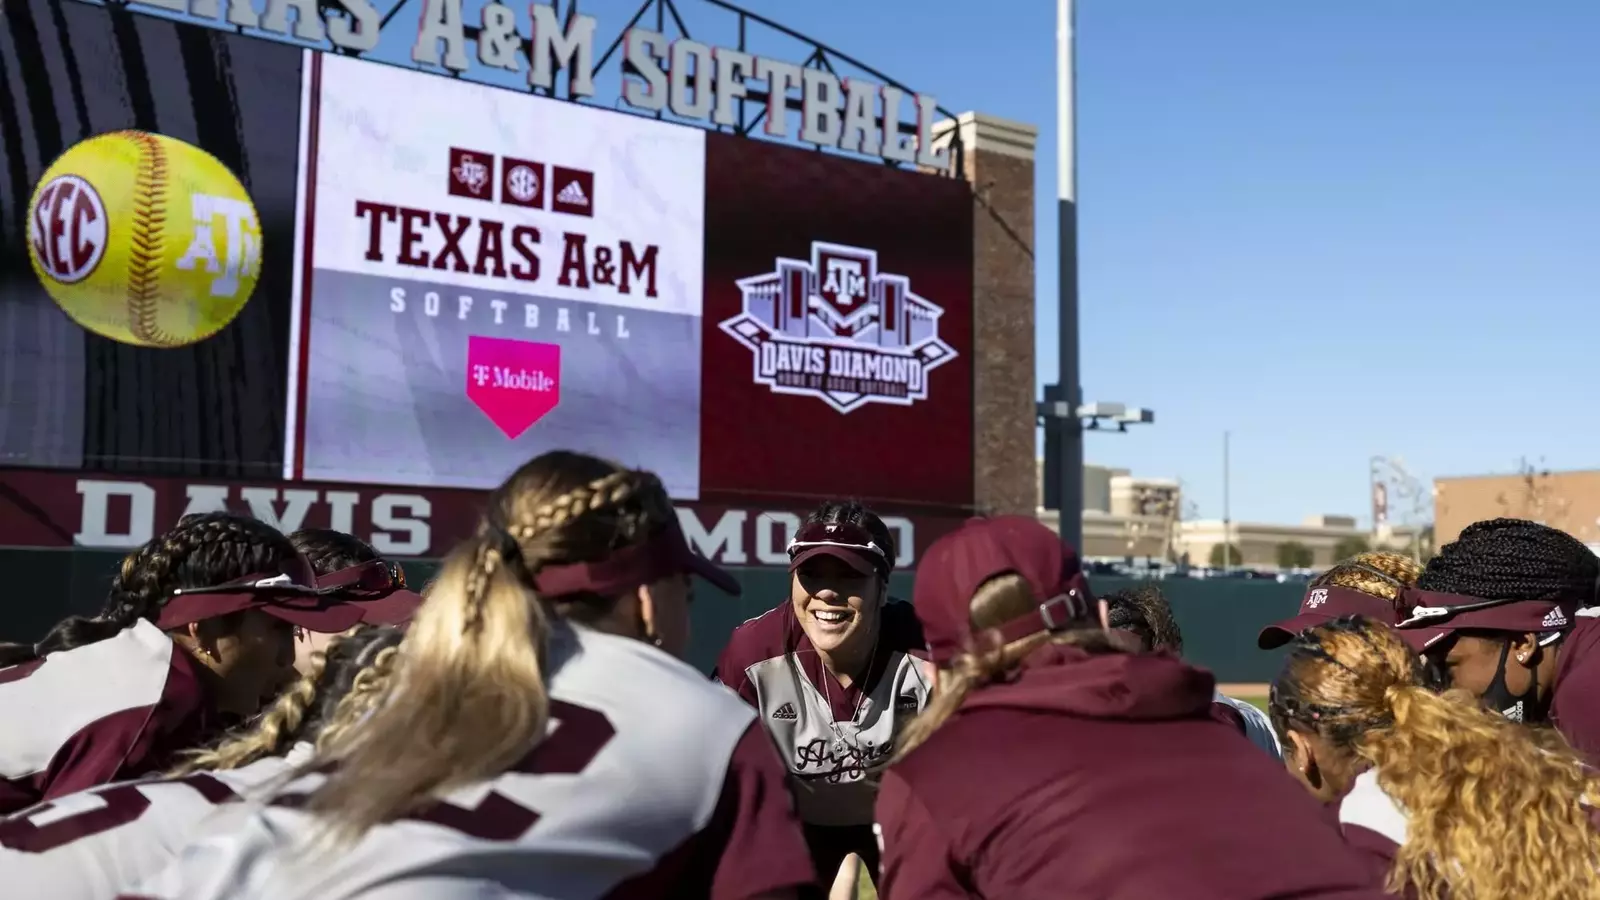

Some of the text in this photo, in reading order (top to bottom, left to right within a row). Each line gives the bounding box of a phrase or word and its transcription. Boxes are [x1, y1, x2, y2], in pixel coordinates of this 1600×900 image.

[412, 0, 597, 96] A&M
[623, 27, 950, 168] SOFTBALL
[34, 181, 98, 276] SEC
[355, 199, 659, 298] TEXAS A&M
[390, 287, 630, 338] SOFTBALL
[761, 342, 825, 376] DAVIS
[829, 350, 922, 391] DIAMOND
[1542, 617, 1567, 628] adidas
